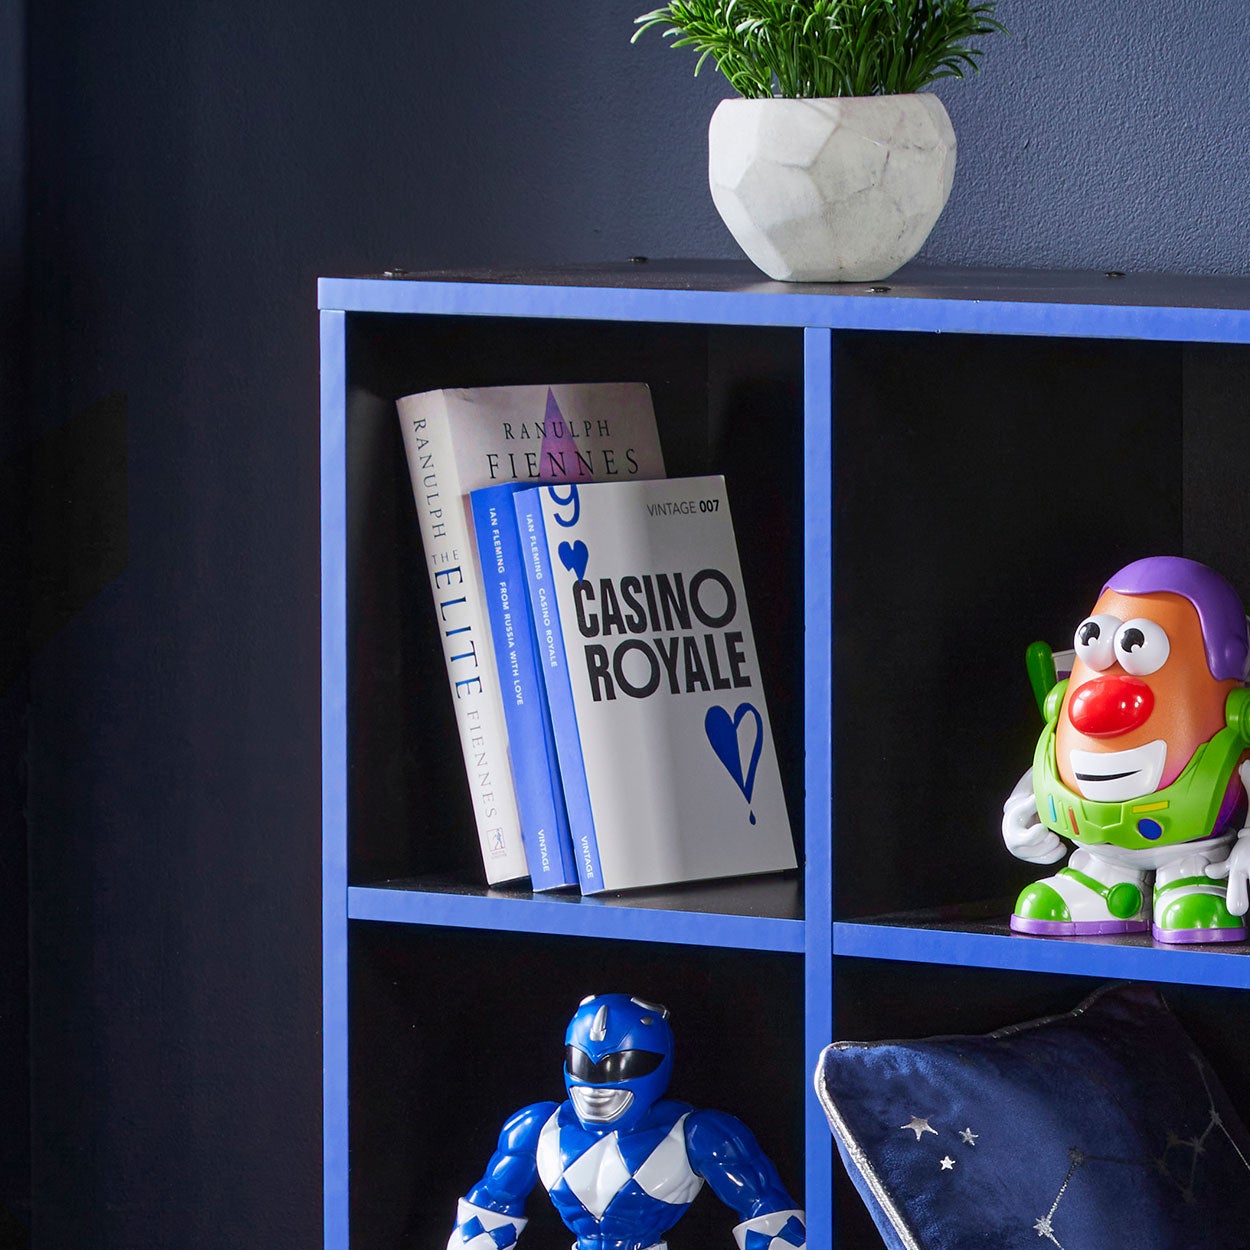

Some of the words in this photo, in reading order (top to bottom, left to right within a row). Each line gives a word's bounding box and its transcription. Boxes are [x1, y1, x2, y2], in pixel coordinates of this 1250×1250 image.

[502, 420, 611, 440] RANULPH
[413, 418, 447, 539] RANULPH
[486, 448, 639, 479] FIENNES
[489, 508, 498, 528] IAN
[526, 514, 535, 534] IAN
[647, 501, 697, 517] VINTAGE
[700, 499, 720, 513] 007
[431, 550, 460, 565] THE
[492, 529, 505, 574] FLEMING
[530, 536, 543, 580] FLEMING
[499, 581, 509, 611] FROM
[538, 588, 551, 627] CASINO
[572, 568, 737, 638] CASINO
[434, 565, 483, 699] ELITE
[504, 613, 514, 648] RUSSIA
[545, 629, 558, 668] ROYALE
[510, 650, 519, 677] WITH
[584, 631, 752, 702] ROYALE
[513, 678, 524, 706] LOVE
[467, 710, 498, 819] FIENNES
[537, 829, 551, 872] VINTAGE
[580, 836, 594, 879] VINTAGE
